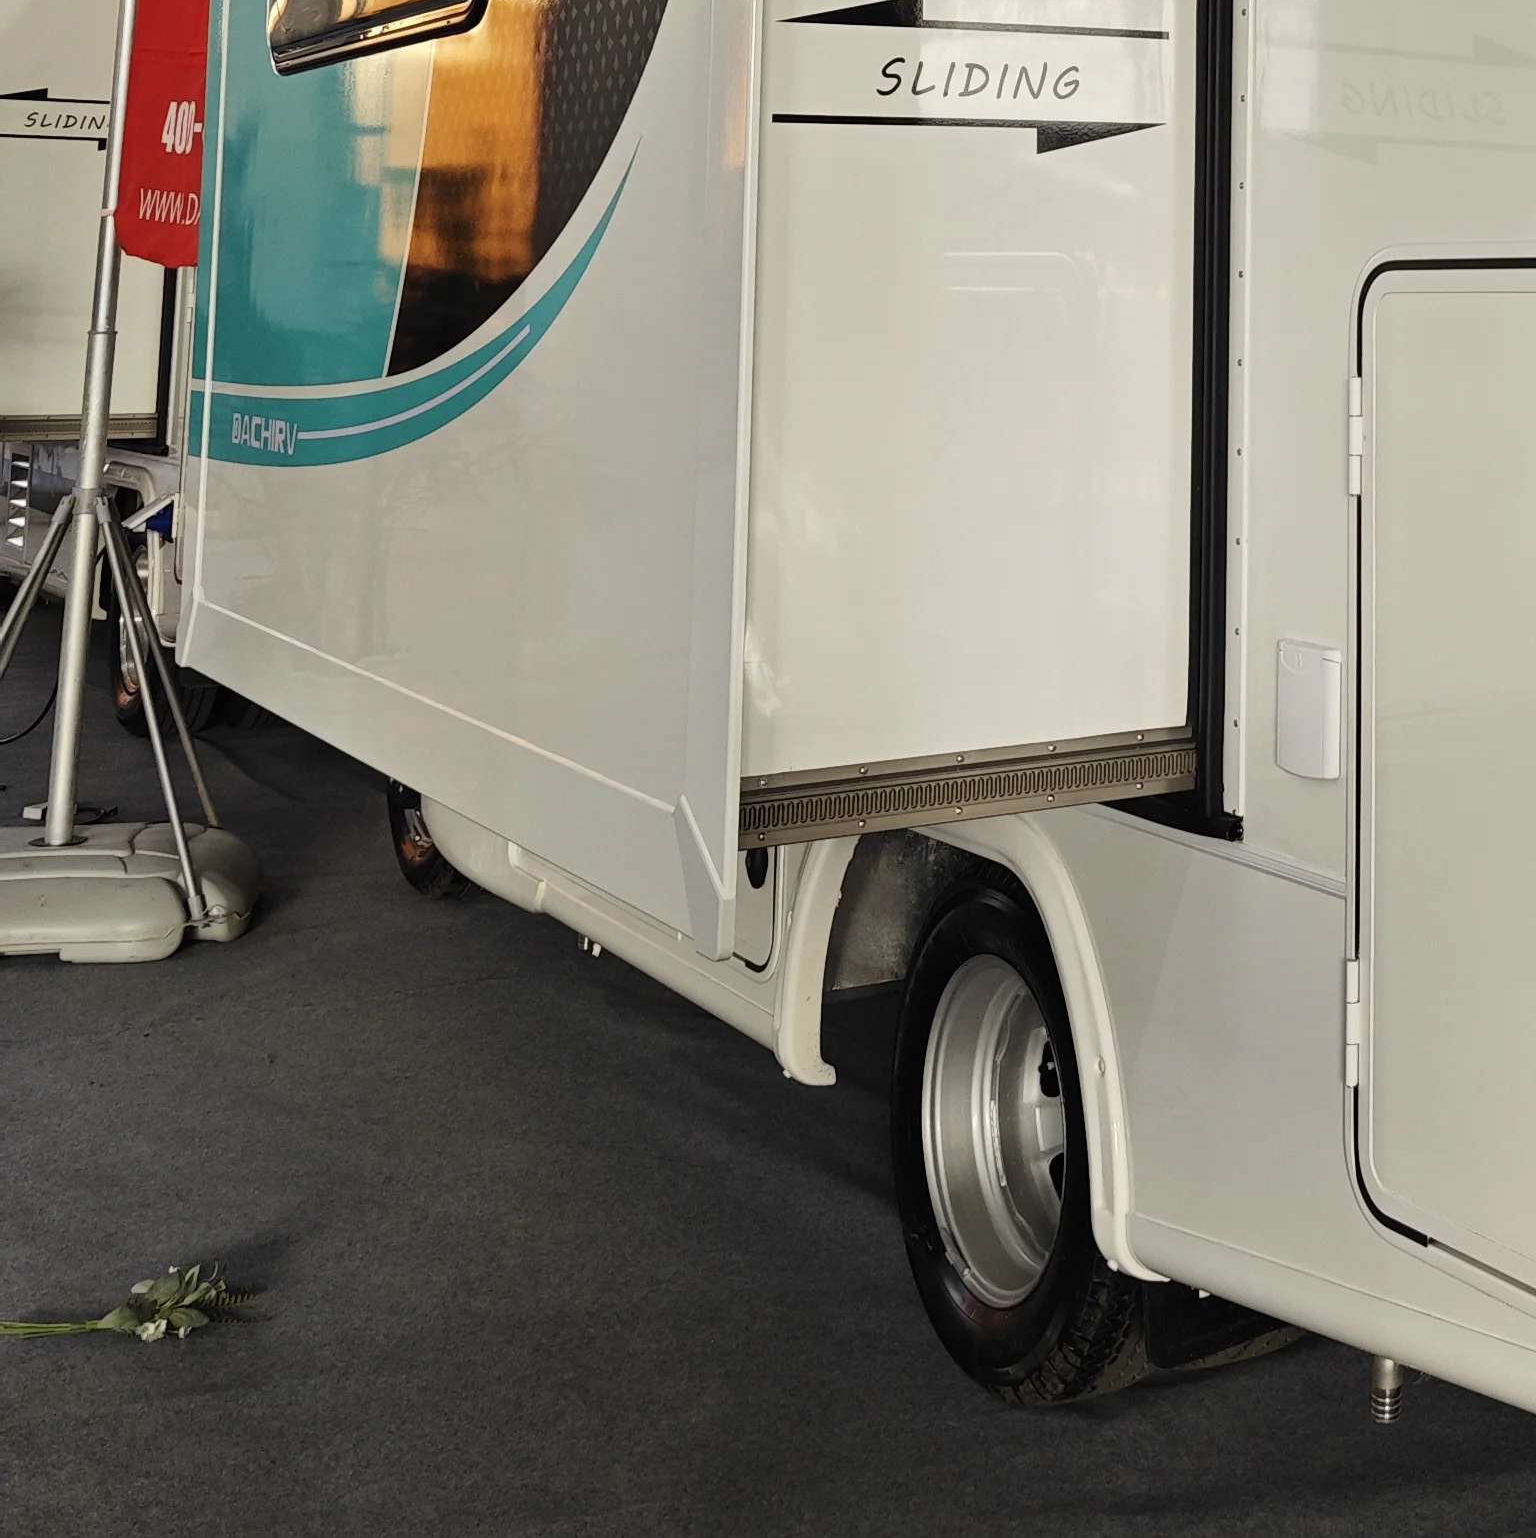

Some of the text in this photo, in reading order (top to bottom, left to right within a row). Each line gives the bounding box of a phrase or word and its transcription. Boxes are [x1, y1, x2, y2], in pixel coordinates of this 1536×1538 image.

[876, 56, 1081, 100] SLIDING
[24, 111, 109, 130] SLIDIN
[161, 100, 205, 155] 400-
[231, 412, 298, 456] DACHIRV
